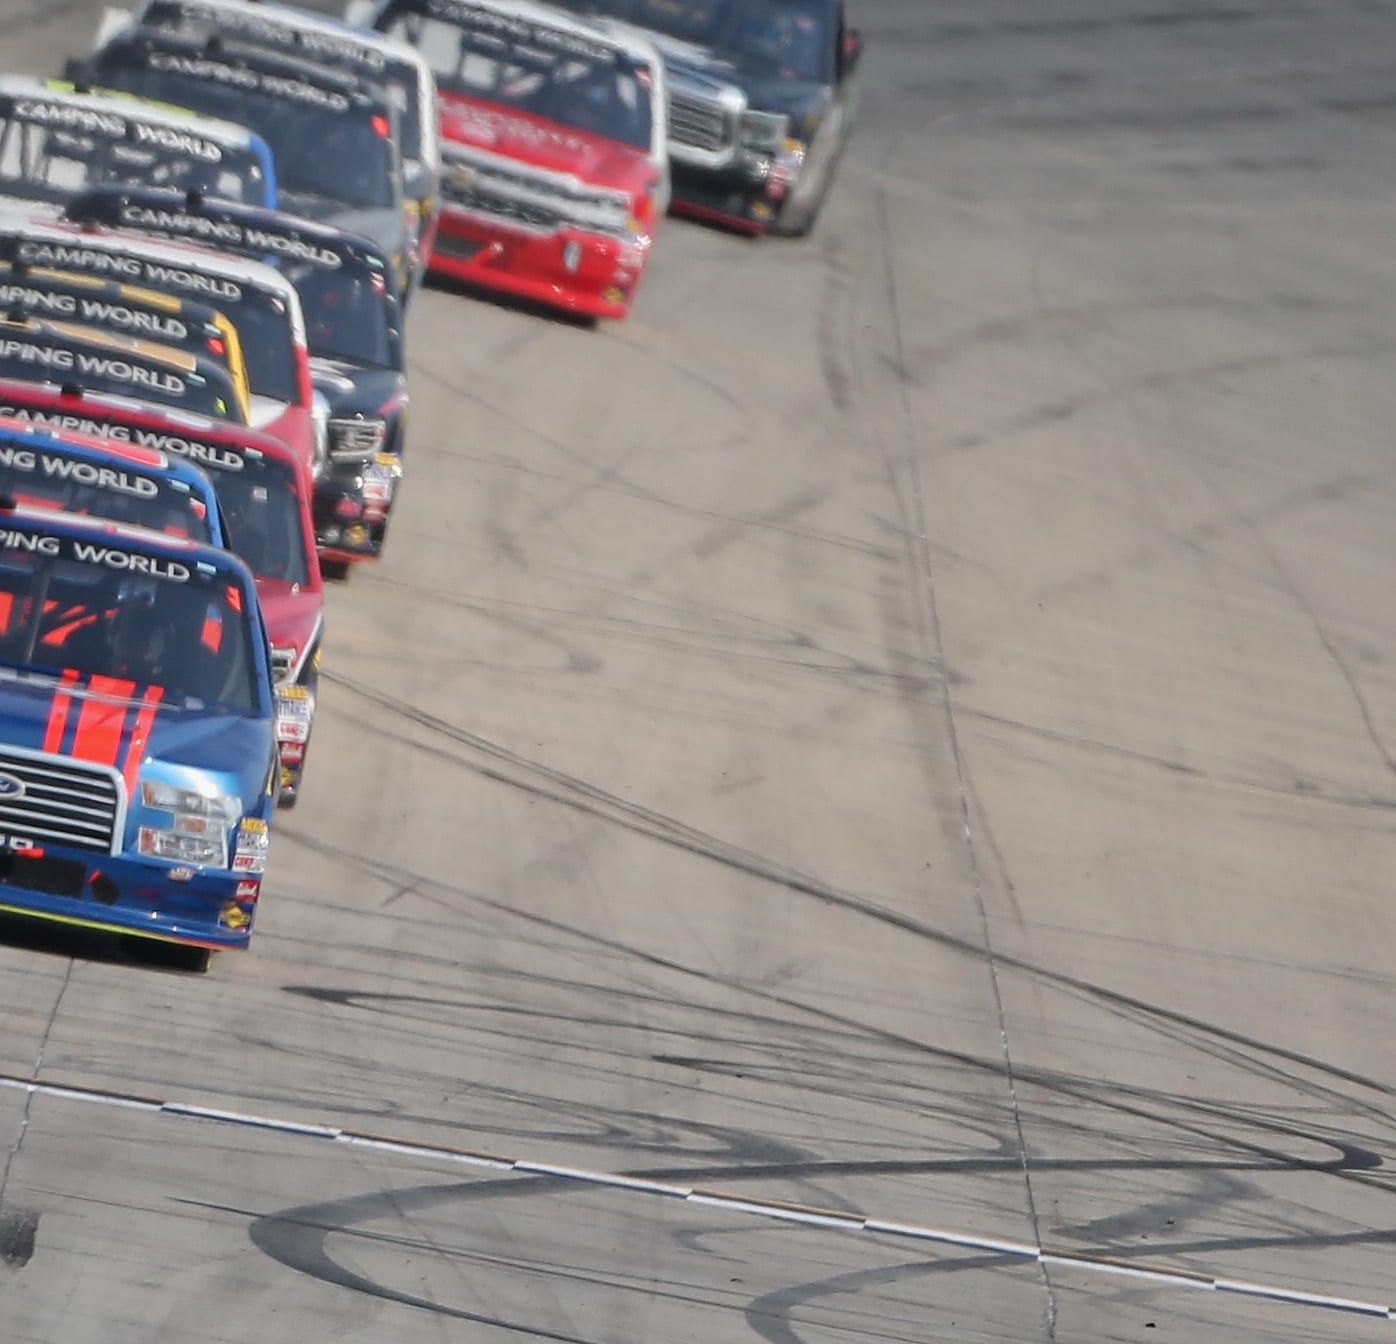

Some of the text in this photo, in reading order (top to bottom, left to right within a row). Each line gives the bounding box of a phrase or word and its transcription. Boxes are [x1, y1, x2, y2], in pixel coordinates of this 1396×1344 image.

[13, 101, 223, 163] CAMPING WORLD
[123, 206, 342, 270] CAMPING WORLD
[18, 241, 242, 303] CAMPING WORLD
[81, 299, 188, 340] WORLD
[78, 354, 186, 395] WORLD
[136, 430, 245, 471] WORLD
[41, 455, 159, 499] WORLD
[74, 542, 191, 584] WORLD
